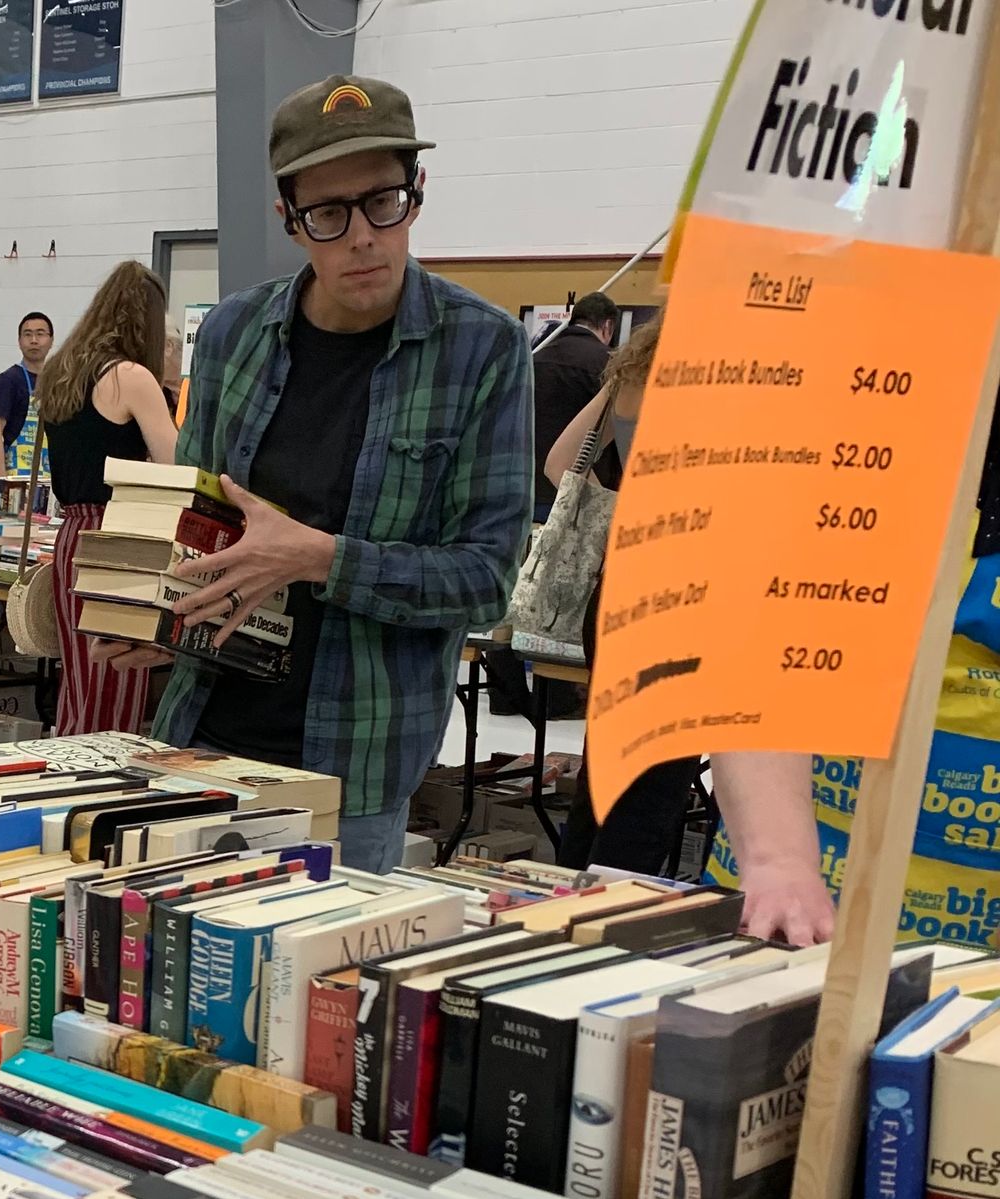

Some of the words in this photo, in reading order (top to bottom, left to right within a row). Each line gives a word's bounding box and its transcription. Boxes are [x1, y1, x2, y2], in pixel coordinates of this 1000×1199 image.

[746, 57, 920, 190] Fiction
[747, 272, 783, 303] Price
[787, 277, 812, 305] List
[716, 359, 747, 385] Book
[748, 360, 804, 387] Bundles
[850, 366, 911, 396] $4.00
[743, 446, 769, 464] Book
[772, 446, 822, 465] Bundles
[832, 442, 893, 470] $2.00
[815, 503, 877, 531] $6.00
[163, 586, 180, 602] Tom
[765, 576, 790, 598] As
[795, 579, 890, 605] marked
[257, 616, 289, 638] Decades
[781, 646, 843, 672] $2.00
[701, 712, 761, 727] MasterCard
[937, 768, 981, 783] Calgary
[942, 779, 976, 791] Reads
[905, 888, 946, 903] Calgary
[30, 907, 47, 950] Lisa
[76, 908, 86, 949] William
[122, 914, 140, 963] APE
[340, 915, 428, 967] MAVIS
[898, 903, 994, 946] book
[6, 929, 21, 977] Andrew
[63, 937, 75, 988] GIBSON
[162, 919, 176, 1010] WILLIAM
[208, 936, 234, 1004] EILEEN
[189, 929, 210, 1015] GOUDGE
[280, 956, 293, 996] MAVIS
[30, 958, 46, 1034] Genova
[491, 1035, 549, 1059] GALLANT
[503, 1021, 541, 1039] MAVIS
[353, 1037, 370, 1099] Mickey
[741, 1082, 806, 1138] JAMES
[658, 1098, 679, 1170] JAMES
